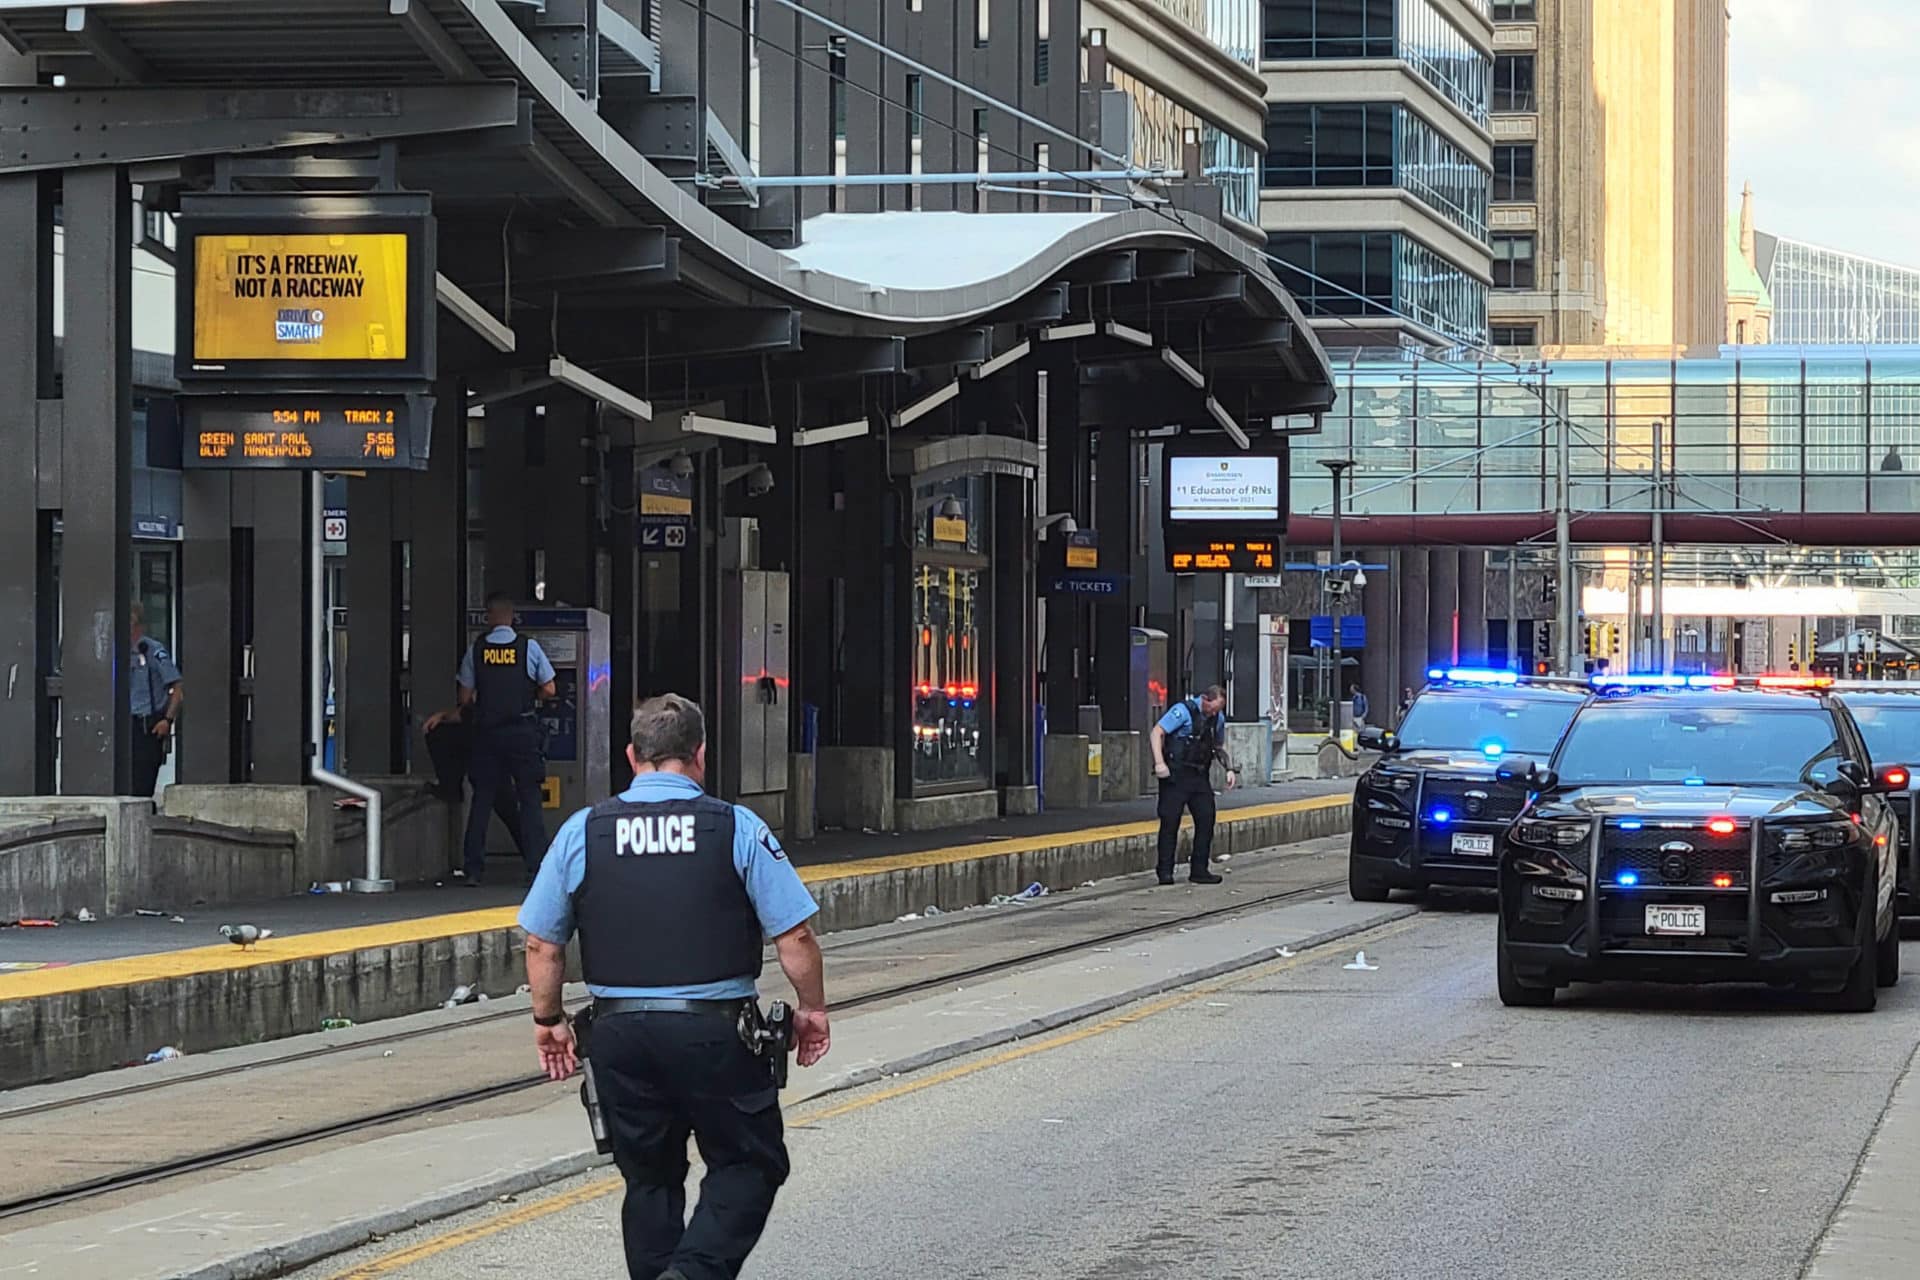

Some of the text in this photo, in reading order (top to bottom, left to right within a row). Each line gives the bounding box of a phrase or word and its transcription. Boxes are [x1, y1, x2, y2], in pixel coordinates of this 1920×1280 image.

[237, 254, 363, 276] IT'S A FREEWAY,
[235, 277, 365, 298] NOT A RACEWAY
[304, 411, 320, 423] PM
[344, 411, 394, 423] TRACK 2
[200, 433, 234, 445] GREEN
[244, 433, 309, 445] SAINT PAUL
[1190, 485, 1236, 495] Educator
[1238, 485, 1249, 495] of
[1252, 485, 1272, 495] RNs
[1069, 581, 1113, 592] TICKETS
[483, 649, 516, 664] POLICE
[616, 815, 696, 855] POLICE
[1462, 839, 1489, 850] POLICE
[1661, 911, 1700, 928] POLICE
